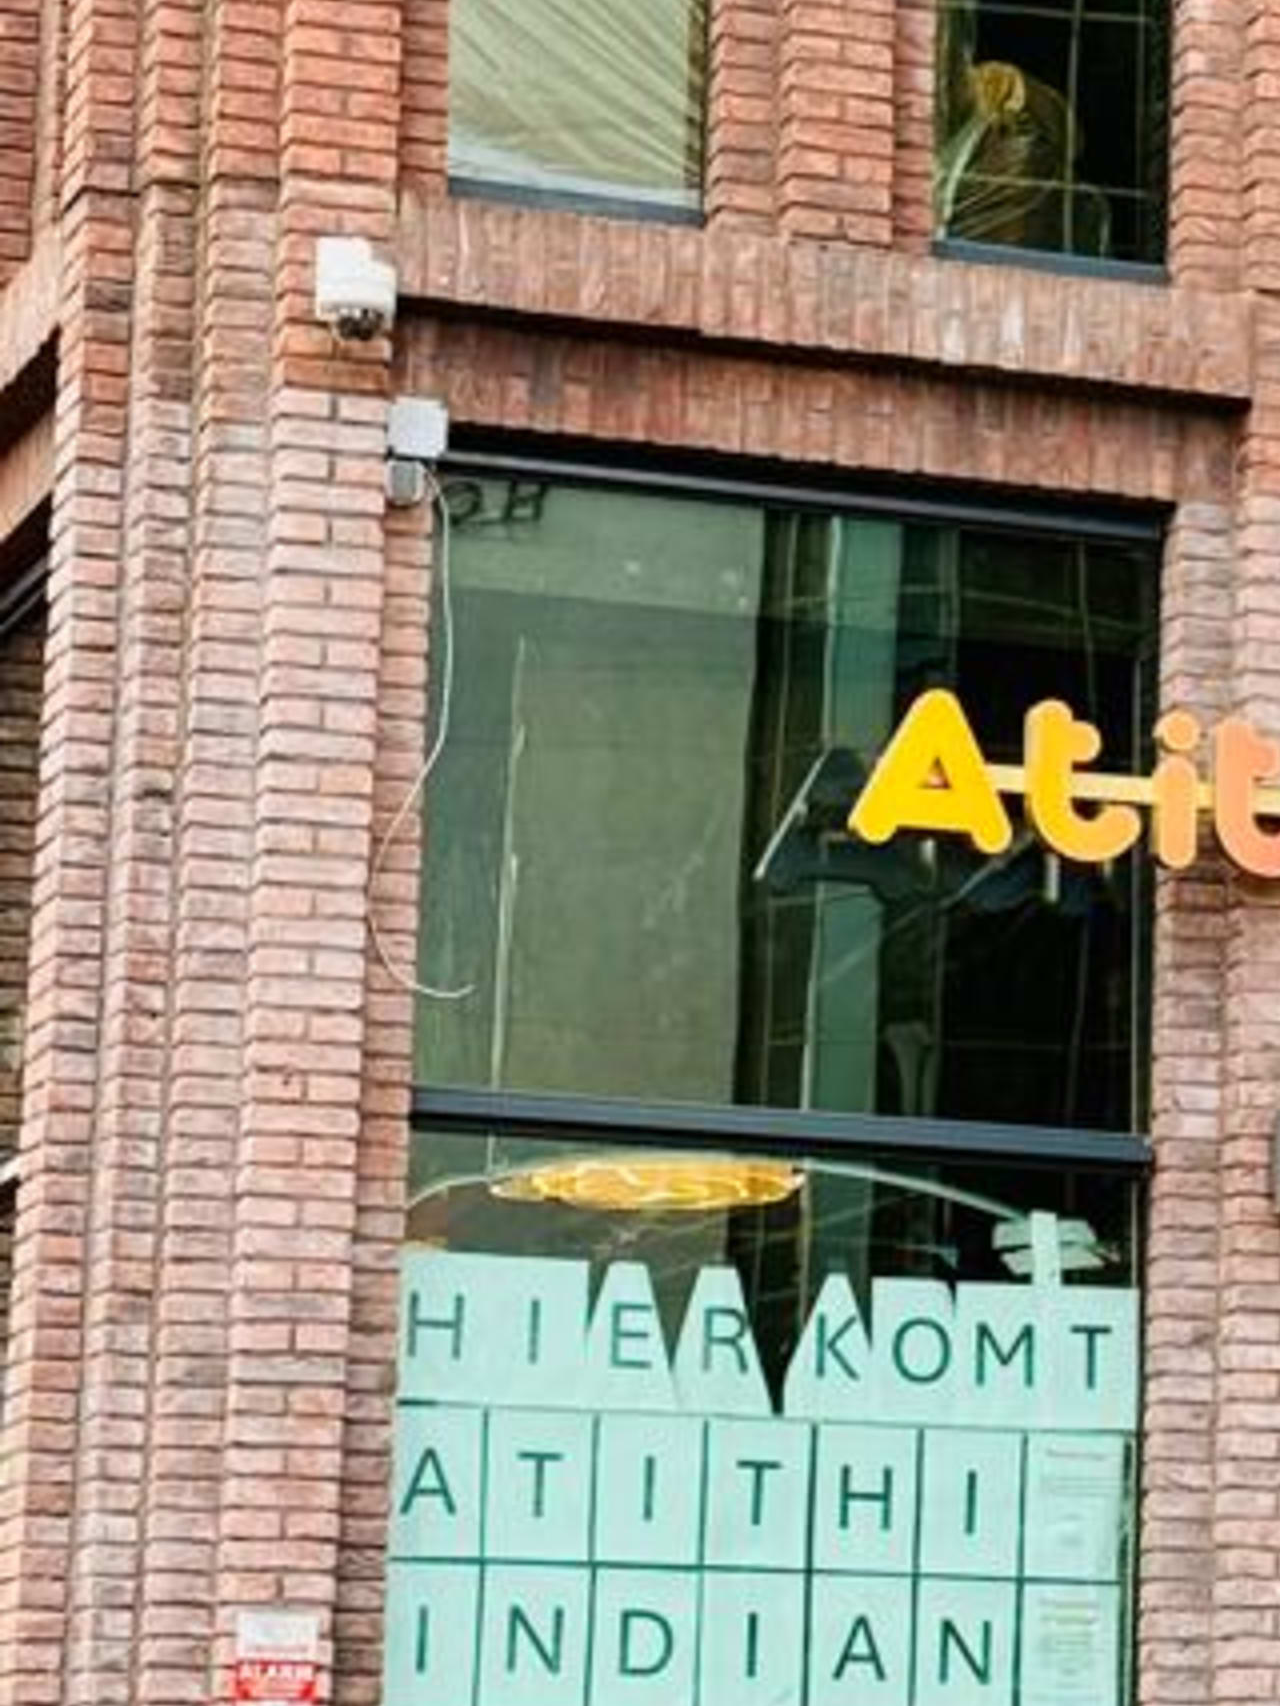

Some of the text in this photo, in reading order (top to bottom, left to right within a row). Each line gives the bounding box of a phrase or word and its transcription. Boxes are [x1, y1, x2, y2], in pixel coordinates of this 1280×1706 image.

[406, 1290, 1112, 1391] HIER KOMT
[400, 1447, 979, 1536] ATITHI
[413, 1604, 994, 1686] INDIAN
